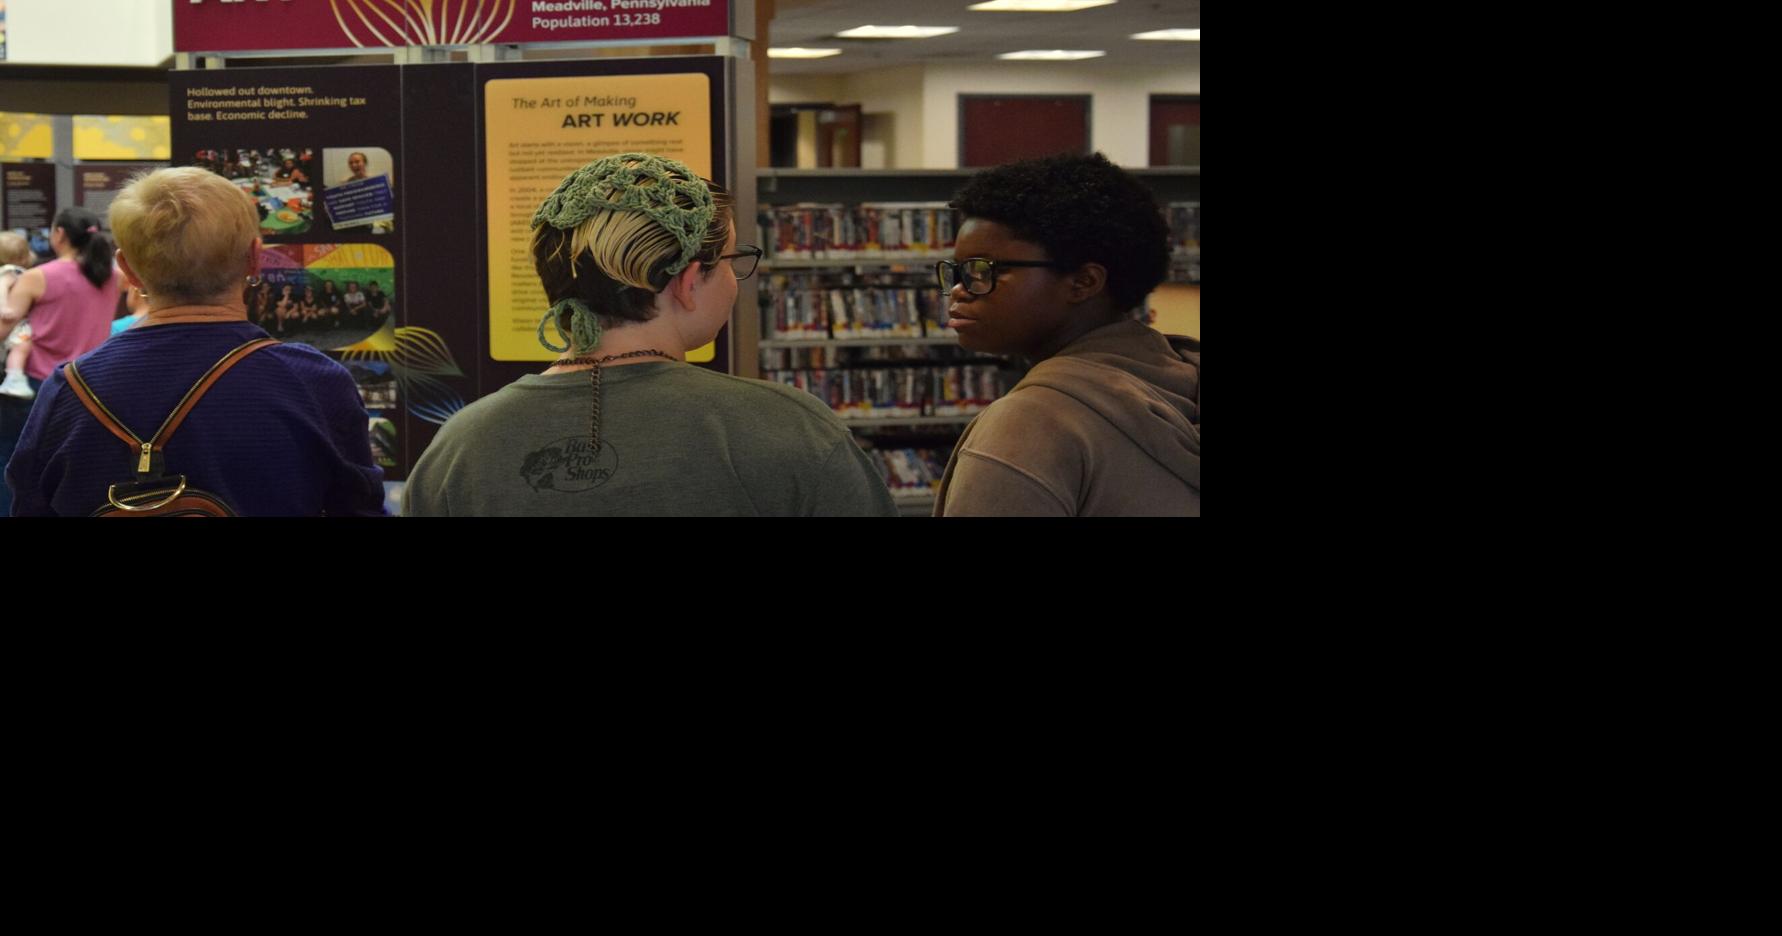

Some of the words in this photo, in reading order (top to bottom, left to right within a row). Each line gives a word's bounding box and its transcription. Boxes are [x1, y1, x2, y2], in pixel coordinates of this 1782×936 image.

[532, 0, 607, 12] Meadville,
[611, 0, 711, 11] Pennsylvania
[532, 15, 610, 30] Population
[613, 13, 661, 27] 13,238
[187, 87, 236, 97] Hollowed
[238, 87, 256, 96] out
[257, 86, 313, 96] downtown.
[187, 98, 261, 109] Environmental
[263, 98, 296, 109] blight.
[298, 97, 347, 108] Shrinking
[512, 98, 537, 110] The
[540, 97, 561, 109] Art
[565, 96, 582, 108] of
[584, 95, 637, 108] Making
[187, 111, 213, 121] base.
[216, 110, 265, 120] Economic
[268, 109, 309, 120] decline.
[561, 113, 605, 129] ART
[612, 111, 681, 128] WORK
[564, 453, 593, 468] Pro
[564, 466, 611, 484] Shops
